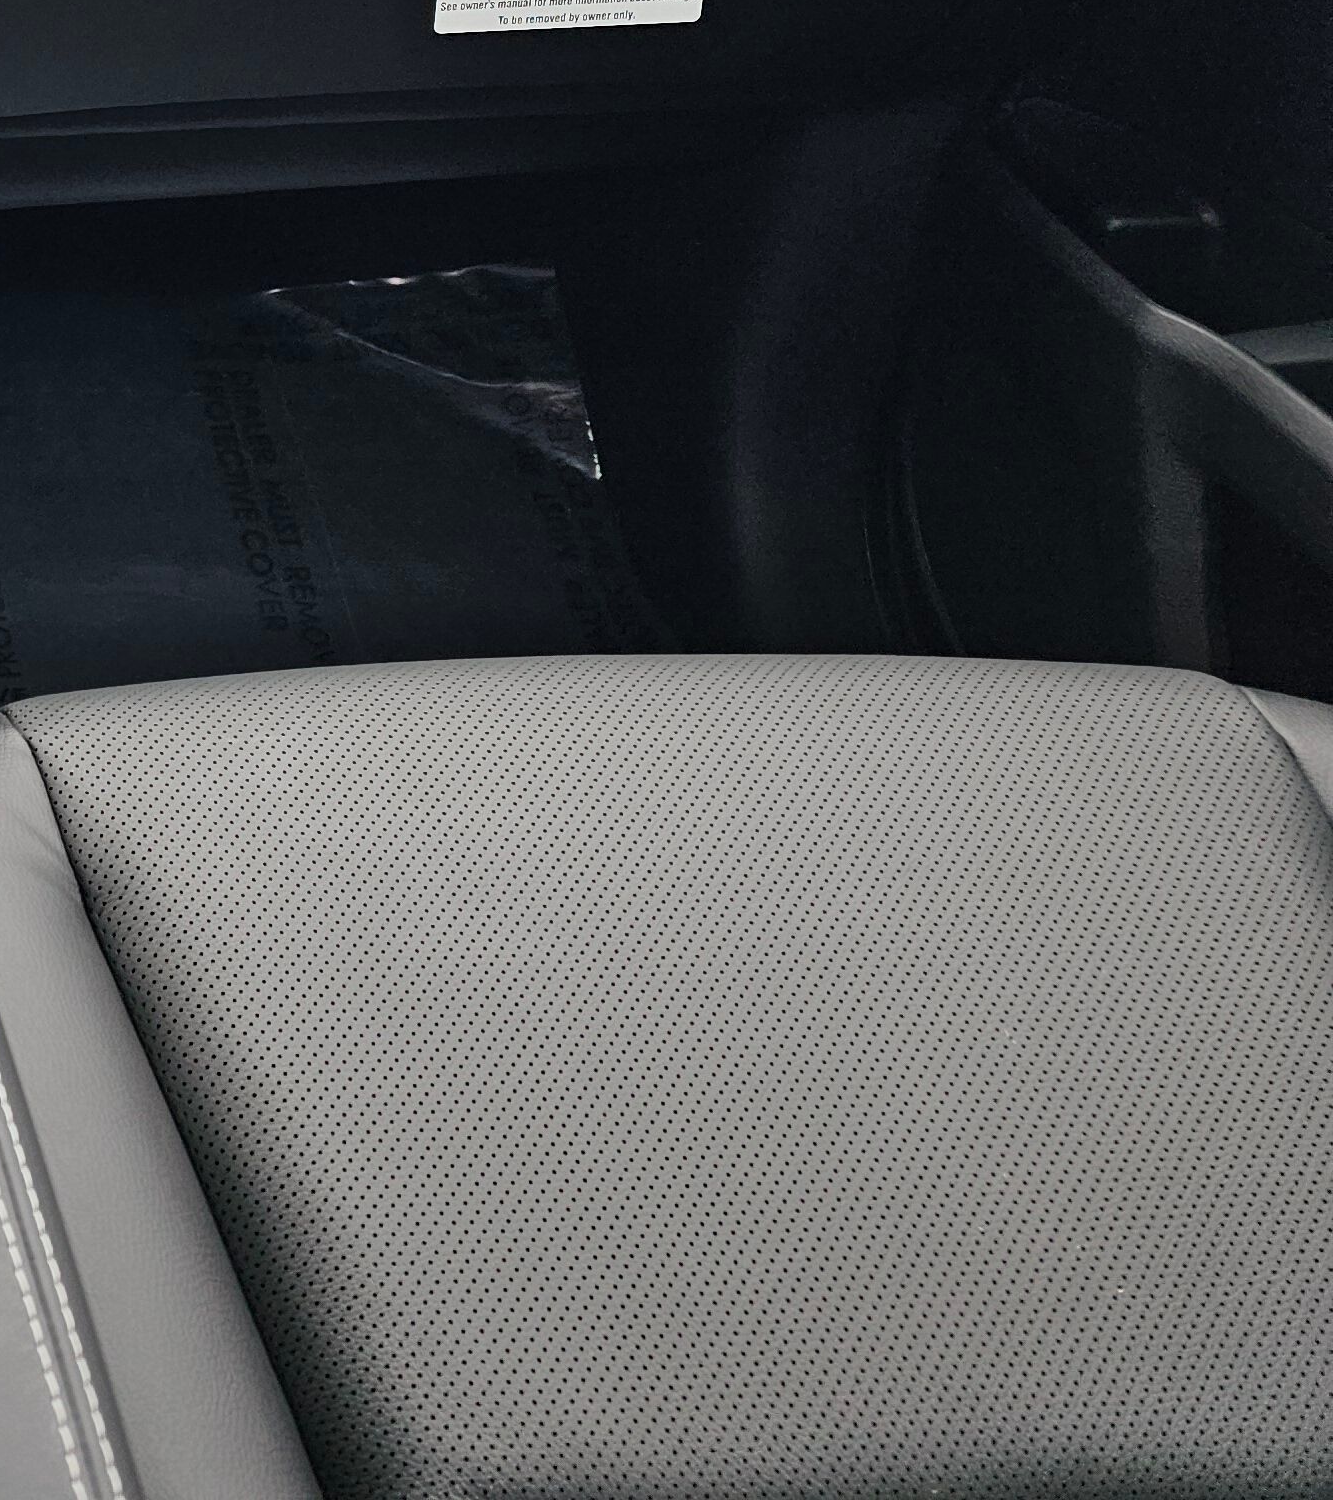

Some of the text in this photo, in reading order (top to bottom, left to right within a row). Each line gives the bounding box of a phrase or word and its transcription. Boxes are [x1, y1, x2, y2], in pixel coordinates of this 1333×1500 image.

[440, 1, 458, 11] See
[460, 0, 495, 10] owner's
[498, 10, 636, 25] To be removed by owner only.
